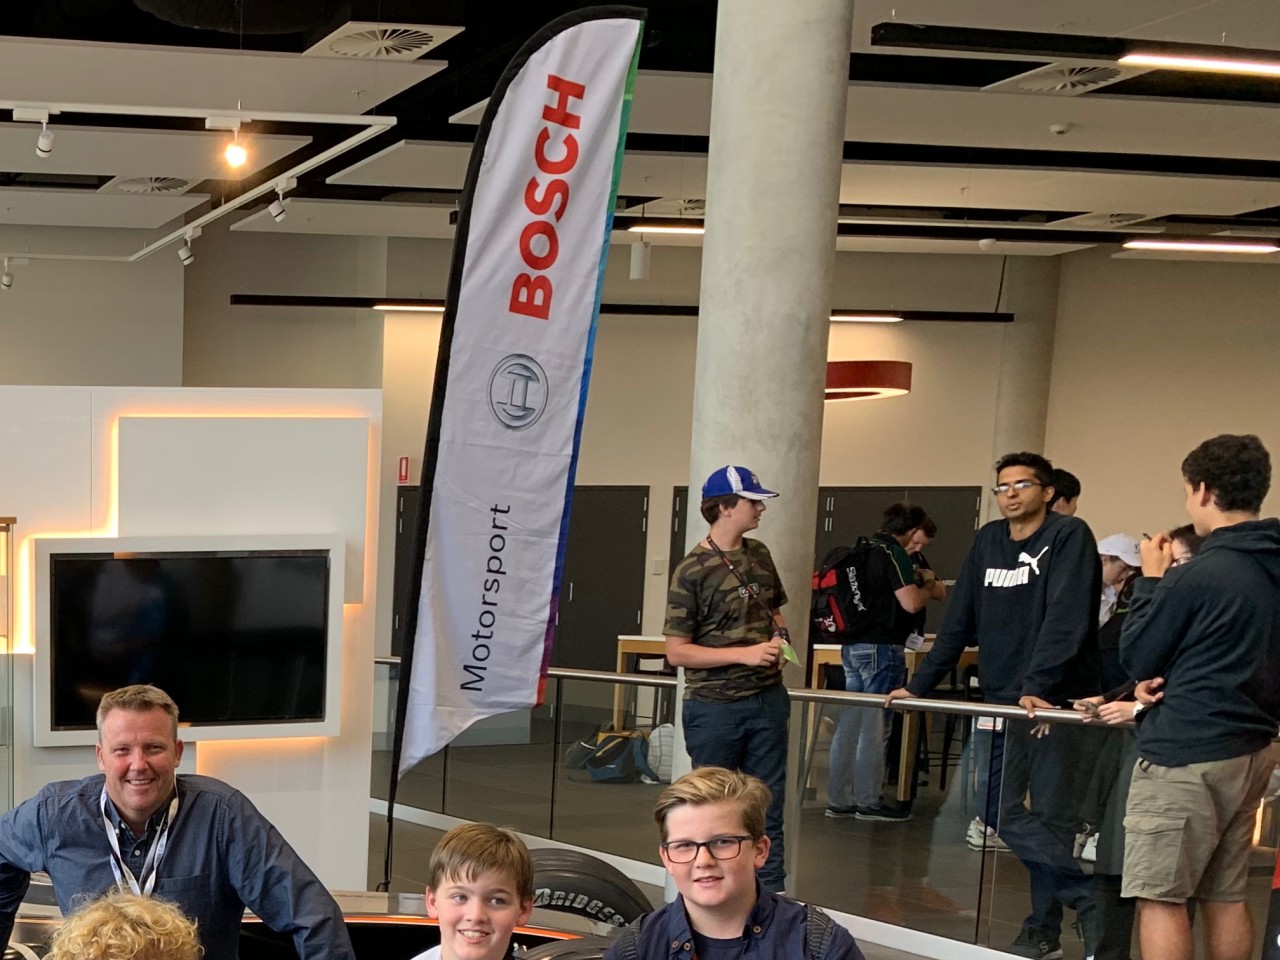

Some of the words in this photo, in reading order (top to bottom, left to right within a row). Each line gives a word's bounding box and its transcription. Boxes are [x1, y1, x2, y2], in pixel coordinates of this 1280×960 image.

[509, 74, 586, 320] BOSCH
[460, 504, 511, 691] Motorsport
[984, 566, 1029, 587] PUMA
[532, 888, 629, 927] BRIDGES
